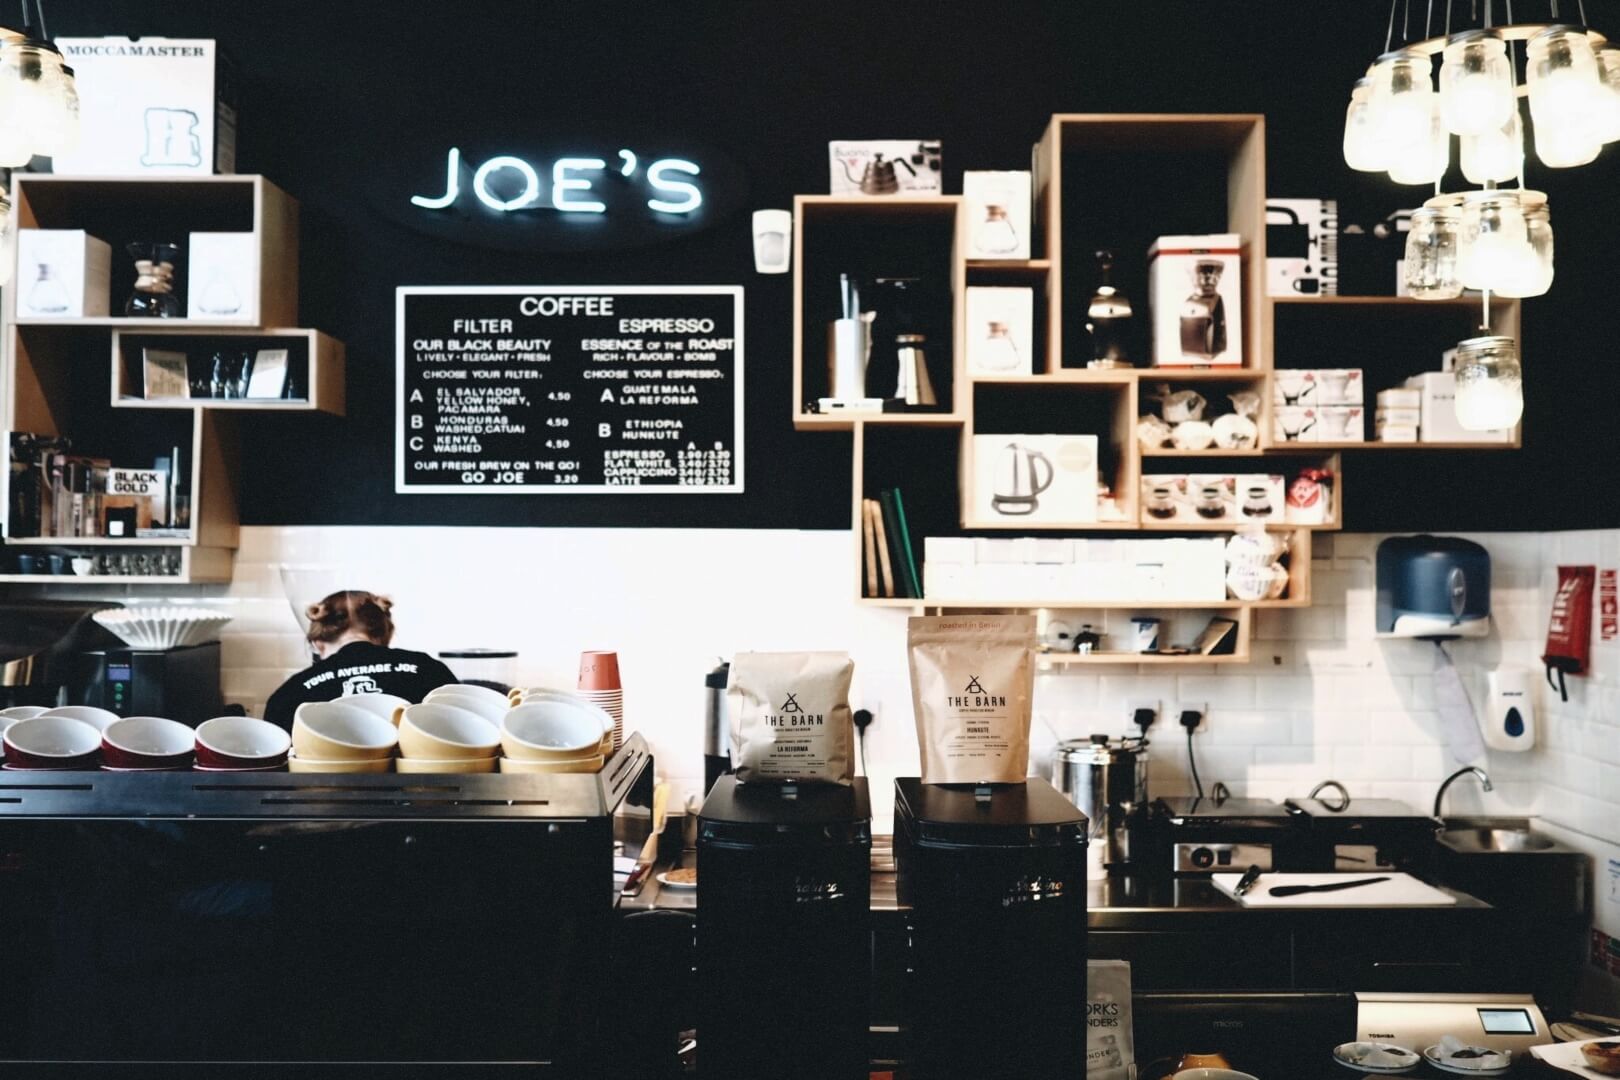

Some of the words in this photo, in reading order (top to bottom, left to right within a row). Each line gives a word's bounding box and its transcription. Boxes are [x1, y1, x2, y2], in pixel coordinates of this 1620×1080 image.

[66, 46, 205, 57] MOCCAMASTER
[410, 147, 702, 213] JOE'S
[520, 297, 614, 316] COFFEE
[453, 319, 513, 334] FILTER
[619, 318, 714, 333] ESPRESSO
[413, 339, 443, 351] OUR
[447, 339, 493, 351] BLACK
[497, 339, 551, 351] BEAUTY
[581, 339, 643, 351] ESSENCE
[646, 342, 661, 350] OF
[664, 342, 684, 350] THE
[688, 339, 734, 350] ROAST
[416, 353, 454, 362] LIVELY
[462, 353, 509, 362] ELEGANT
[517, 353, 551, 362] FRESH
[592, 353, 618, 361] RICH
[626, 353, 674, 361] FLAVOUR
[684, 353, 716, 361] BOMB
[423, 370, 467, 379] CHOOSE
[472, 370, 501, 379] YOUR
[583, 370, 629, 379] CHOOSE
[633, 370, 663, 379] YOUR
[437, 388, 451, 396] EL
[622, 385, 696, 394] GUATEMALA
[410, 389, 424, 403] A
[548, 392, 571, 401] 4.50
[600, 388, 614, 402] A
[436, 397, 483, 405] YELLOW
[620, 396, 635, 404] LA
[639, 396, 699, 404] REFORMA
[438, 405, 501, 413] PACAMARA
[411, 415, 424, 429] B
[440, 416, 508, 424] HONDURAS
[546, 418, 569, 427] 4.50
[625, 420, 683, 429] ETHIOPIA
[598, 423, 612, 437] B
[622, 431, 679, 439] HUNKUTE
[410, 437, 424, 451] C
[437, 436, 478, 444] KENYA
[545, 440, 570, 449] 4.50
[433, 444, 482, 453] WASHED
[687, 441, 696, 450] A
[604, 450, 666, 459] ESPRESSO
[414, 461, 439, 470] OUR
[442, 461, 476, 470] FRESH
[479, 461, 510, 470] BREW
[513, 461, 530, 470] ON
[534, 461, 555, 470] THE
[558, 461, 580, 470] GO!
[604, 459, 631, 468] FLAT
[635, 459, 671, 468] WHITE
[604, 468, 677, 477] CAPPUCCINO
[114, 472, 158, 483] BLACK
[461, 472, 486, 483] GO
[493, 472, 525, 483] JOE
[554, 475, 579, 483] 3.20
[605, 477, 641, 485] LATTE
[114, 484, 149, 493] GOLD
[303, 671, 335, 690] YOUR
[337, 663, 392, 678] AVERAGE
[394, 663, 418, 673] JOE
[948, 697, 969, 707] THE
[975, 696, 1006, 707] BARN
[765, 715, 784, 727] THE
[791, 714, 824, 726] BARN
